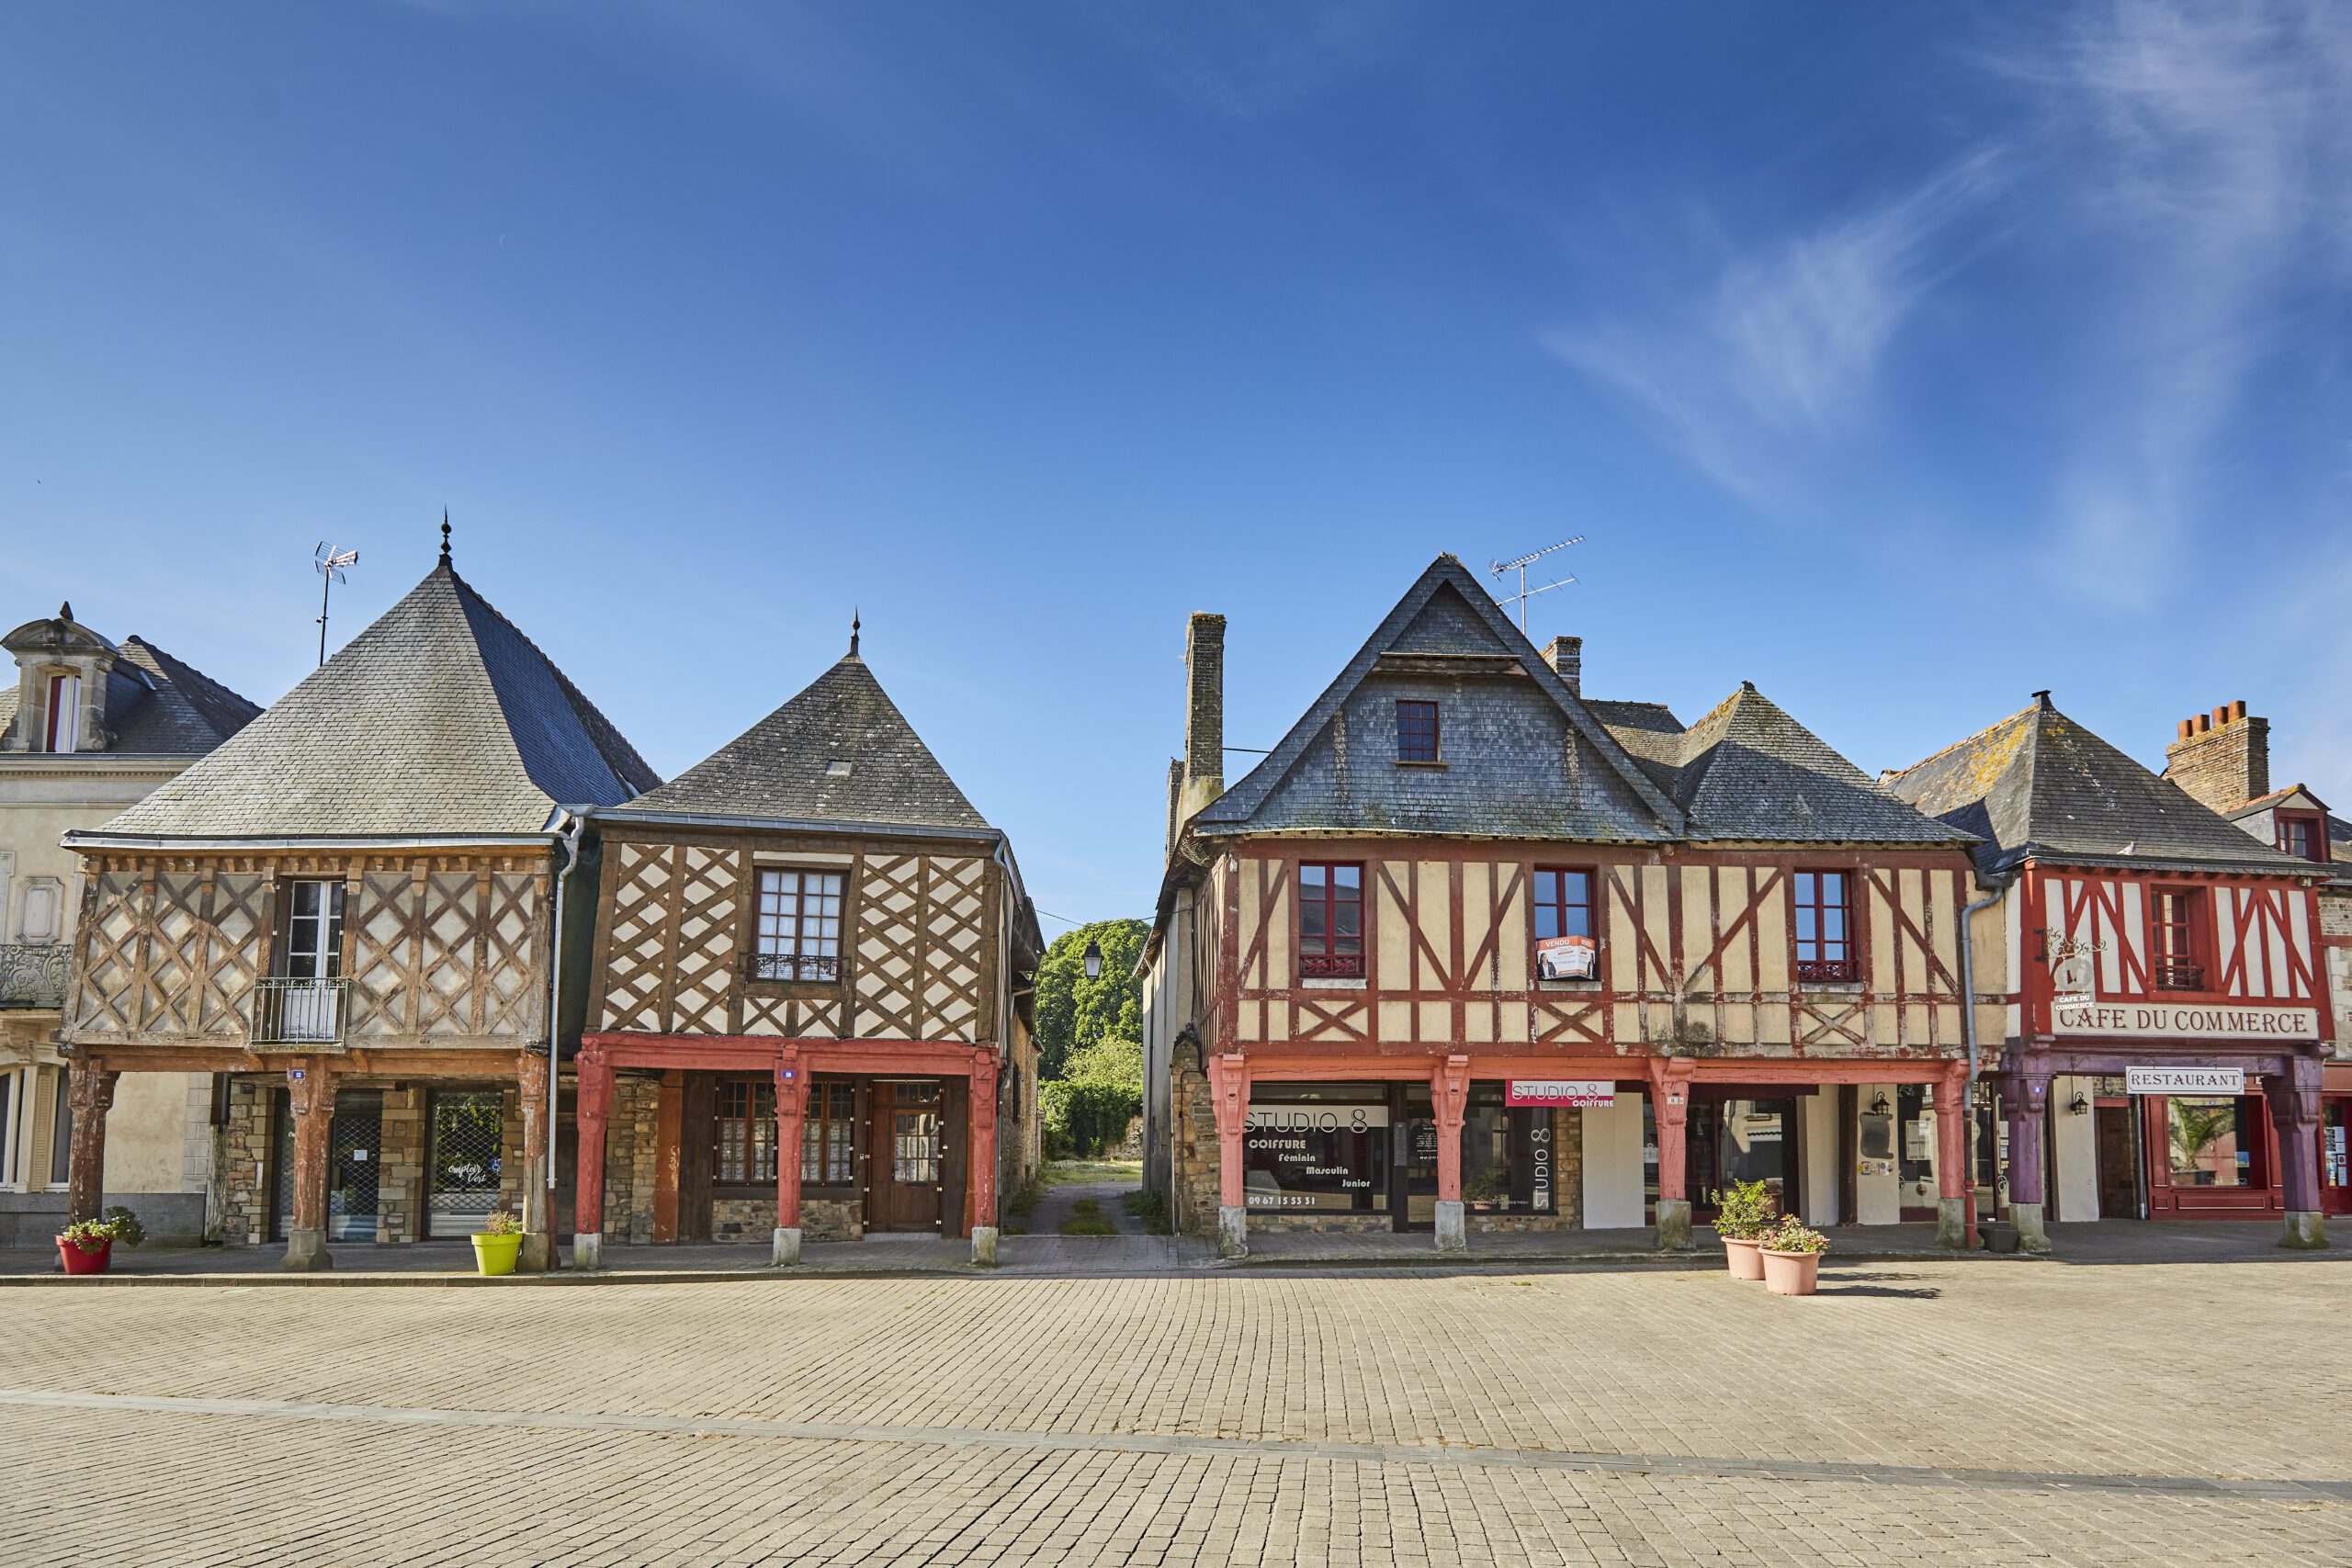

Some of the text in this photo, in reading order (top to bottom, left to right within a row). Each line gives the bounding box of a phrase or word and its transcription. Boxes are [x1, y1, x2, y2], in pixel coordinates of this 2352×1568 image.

[1545, 939, 1570, 947] VENDU
[2055, 1002, 2095, 1010] COMMERCE
[2137, 1010, 2167, 1029] DU
[2174, 1011, 2308, 1033] COMMERCE
[2131, 1074, 2239, 1086] RESTAURANT
[1512, 1084, 1598, 1100] STUDIO 8
[1245, 1109, 1368, 1134] STUDIO 8
[1249, 1139, 1306, 1149] COIFFURE
[1278, 1154, 1316, 1162] Féminin
[1306, 1167, 1349, 1175] Masculin
[1531, 1128, 1551, 1207] STUDIO 8
[1342, 1179, 1371, 1188] Junior
[1249, 1196, 1261, 1205] 09
[1262, 1196, 1274, 1205] 67
[1278, 1196, 1288, 1205] 15
